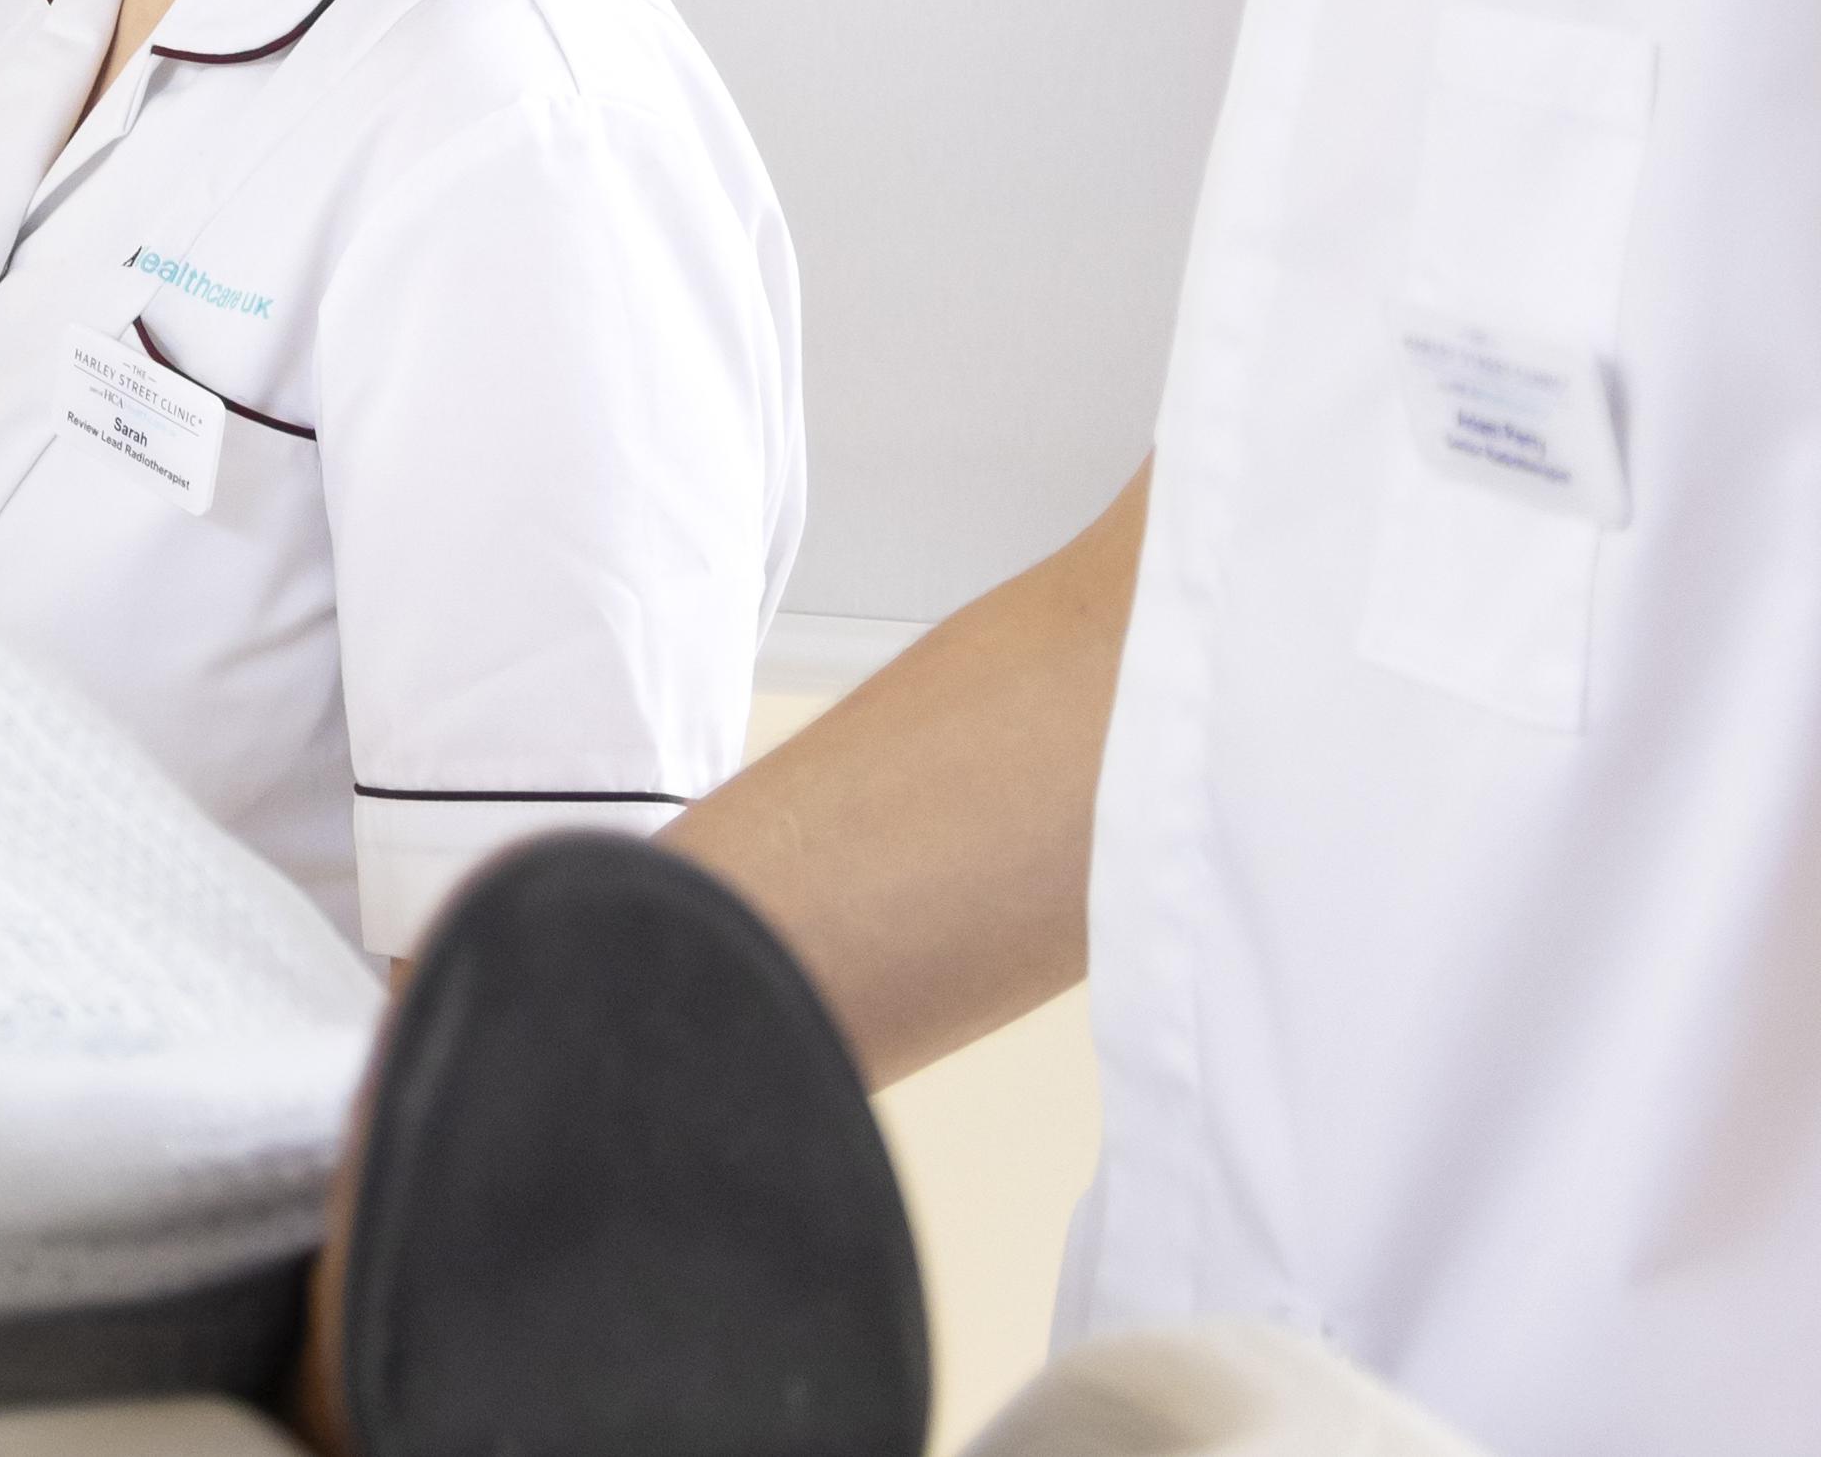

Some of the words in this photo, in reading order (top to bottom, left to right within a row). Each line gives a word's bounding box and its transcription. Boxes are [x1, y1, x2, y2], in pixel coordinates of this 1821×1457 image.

[135, 246, 240, 311] ealthcare
[240, 293, 275, 320] UK
[73, 348, 117, 378] HARLEY
[118, 374, 159, 406] STREET
[160, 397, 197, 427] CLINIC
[131, 364, 147, 379] THE
[67, 410, 100, 437] Review
[101, 429, 124, 451] Lead
[124, 444, 191, 491] Radiotherapist
[113, 416, 148, 447] Sarah
